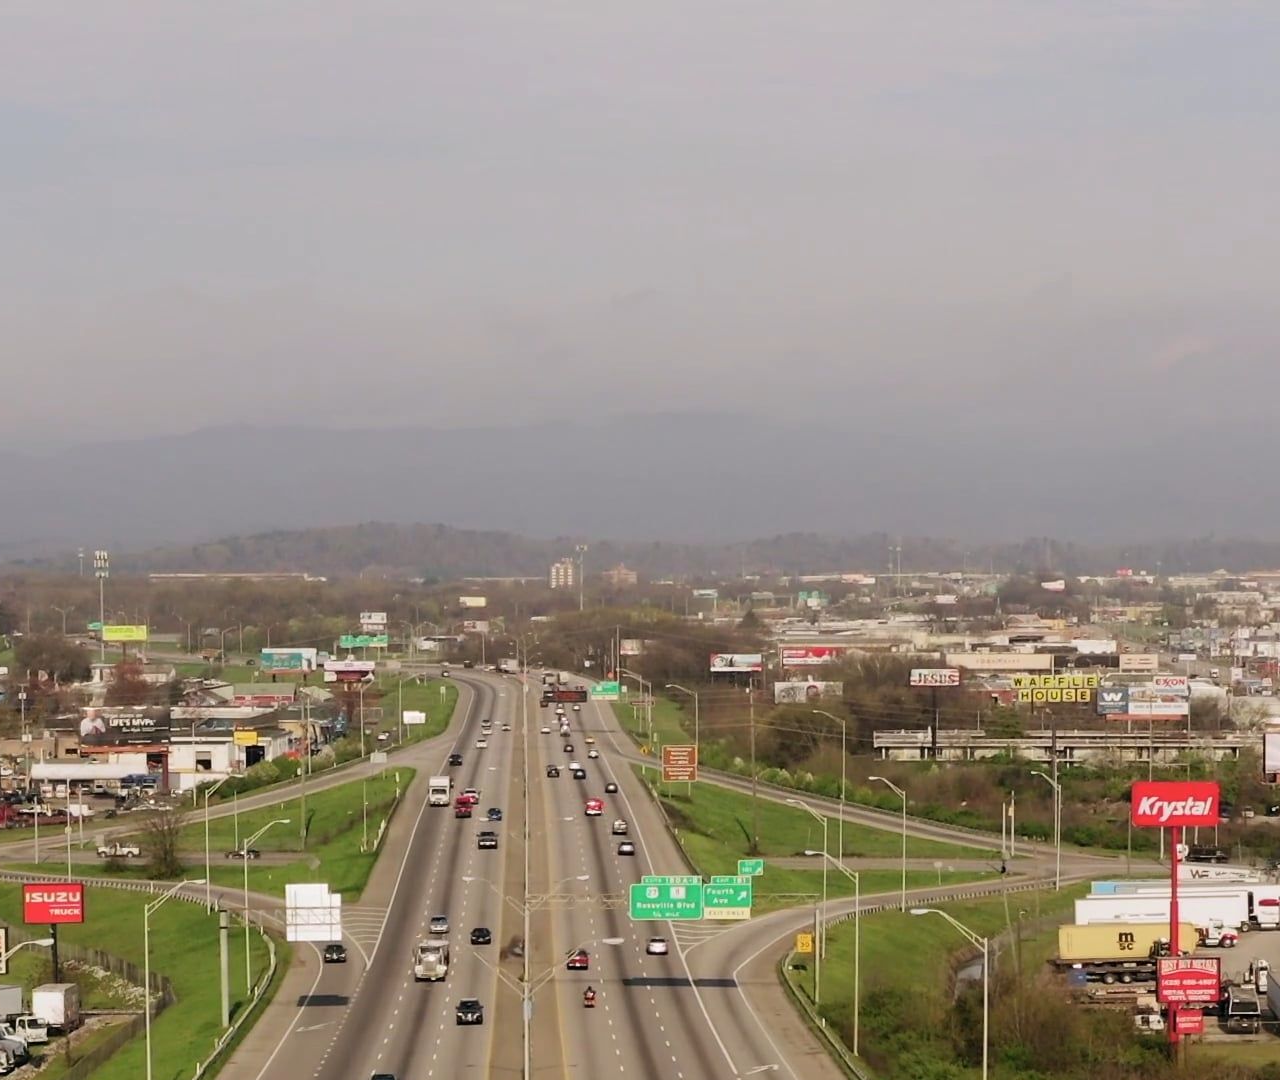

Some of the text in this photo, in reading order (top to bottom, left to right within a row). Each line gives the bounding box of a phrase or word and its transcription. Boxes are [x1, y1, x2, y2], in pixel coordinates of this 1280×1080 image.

[918, 673, 956, 684] JESUS
[1013, 677, 1095, 687] WAFFLE
[1155, 678, 1185, 688] EXXON
[1021, 690, 1088, 700] HOUSE
[1137, 796, 1213, 822] Krystal
[25, 892, 81, 903] ISUZU
